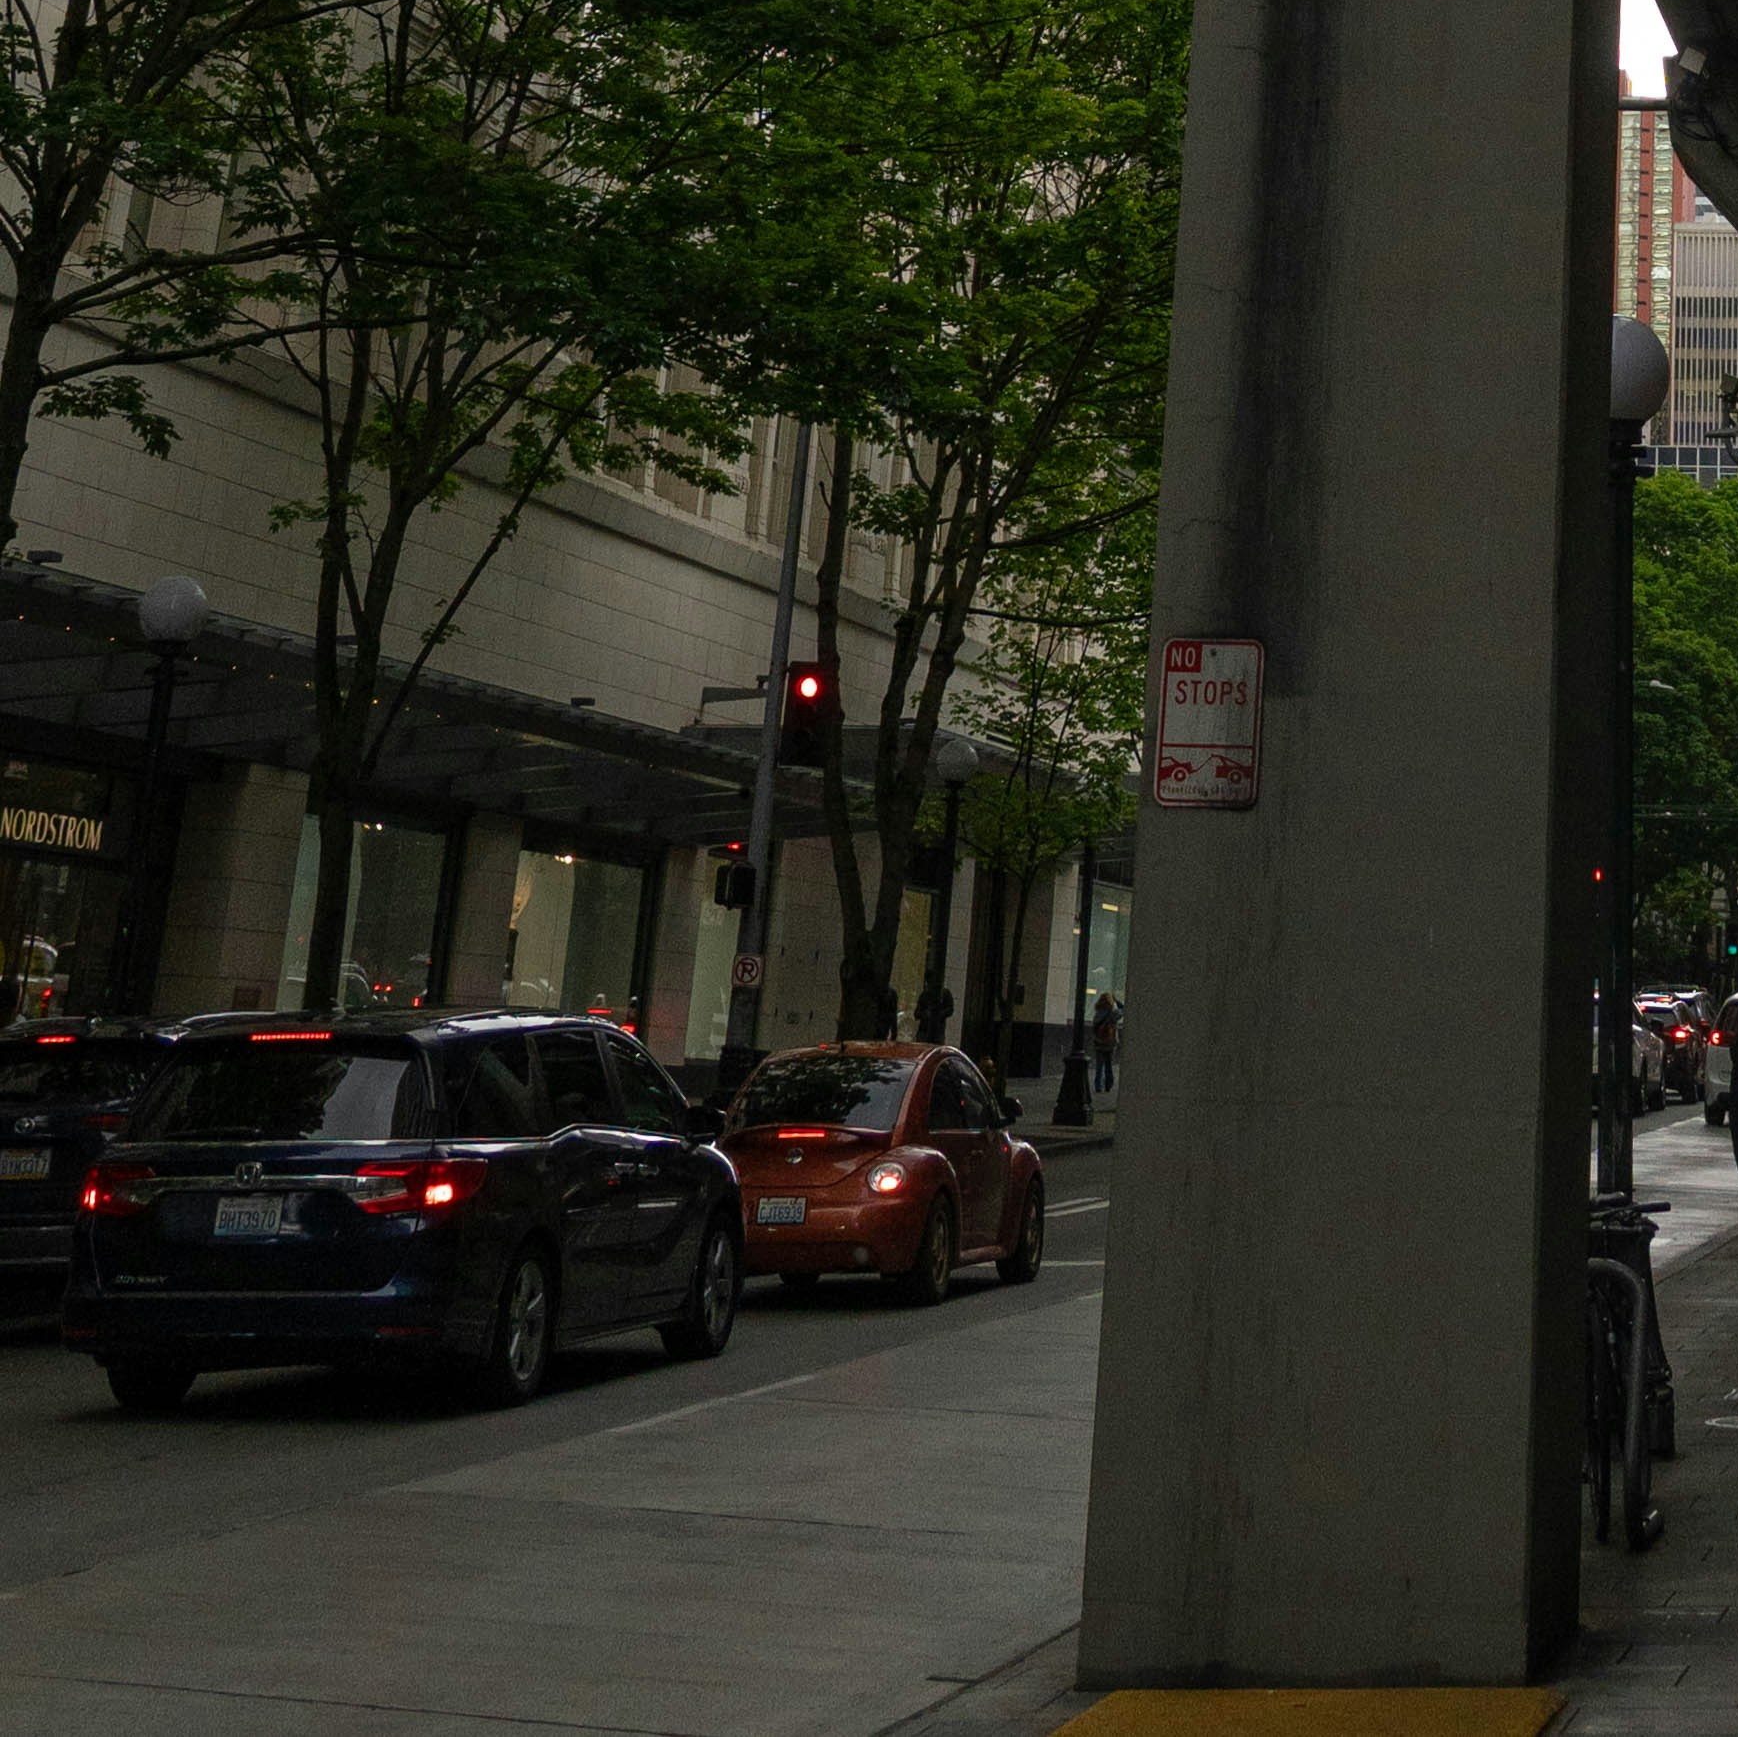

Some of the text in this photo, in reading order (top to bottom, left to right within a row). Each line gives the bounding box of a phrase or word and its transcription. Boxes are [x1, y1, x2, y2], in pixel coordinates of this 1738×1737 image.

[1170, 646, 1197, 668] NO
[1174, 680, 1247, 705] STOPS
[0, 806, 104, 851] NORDSTROM
